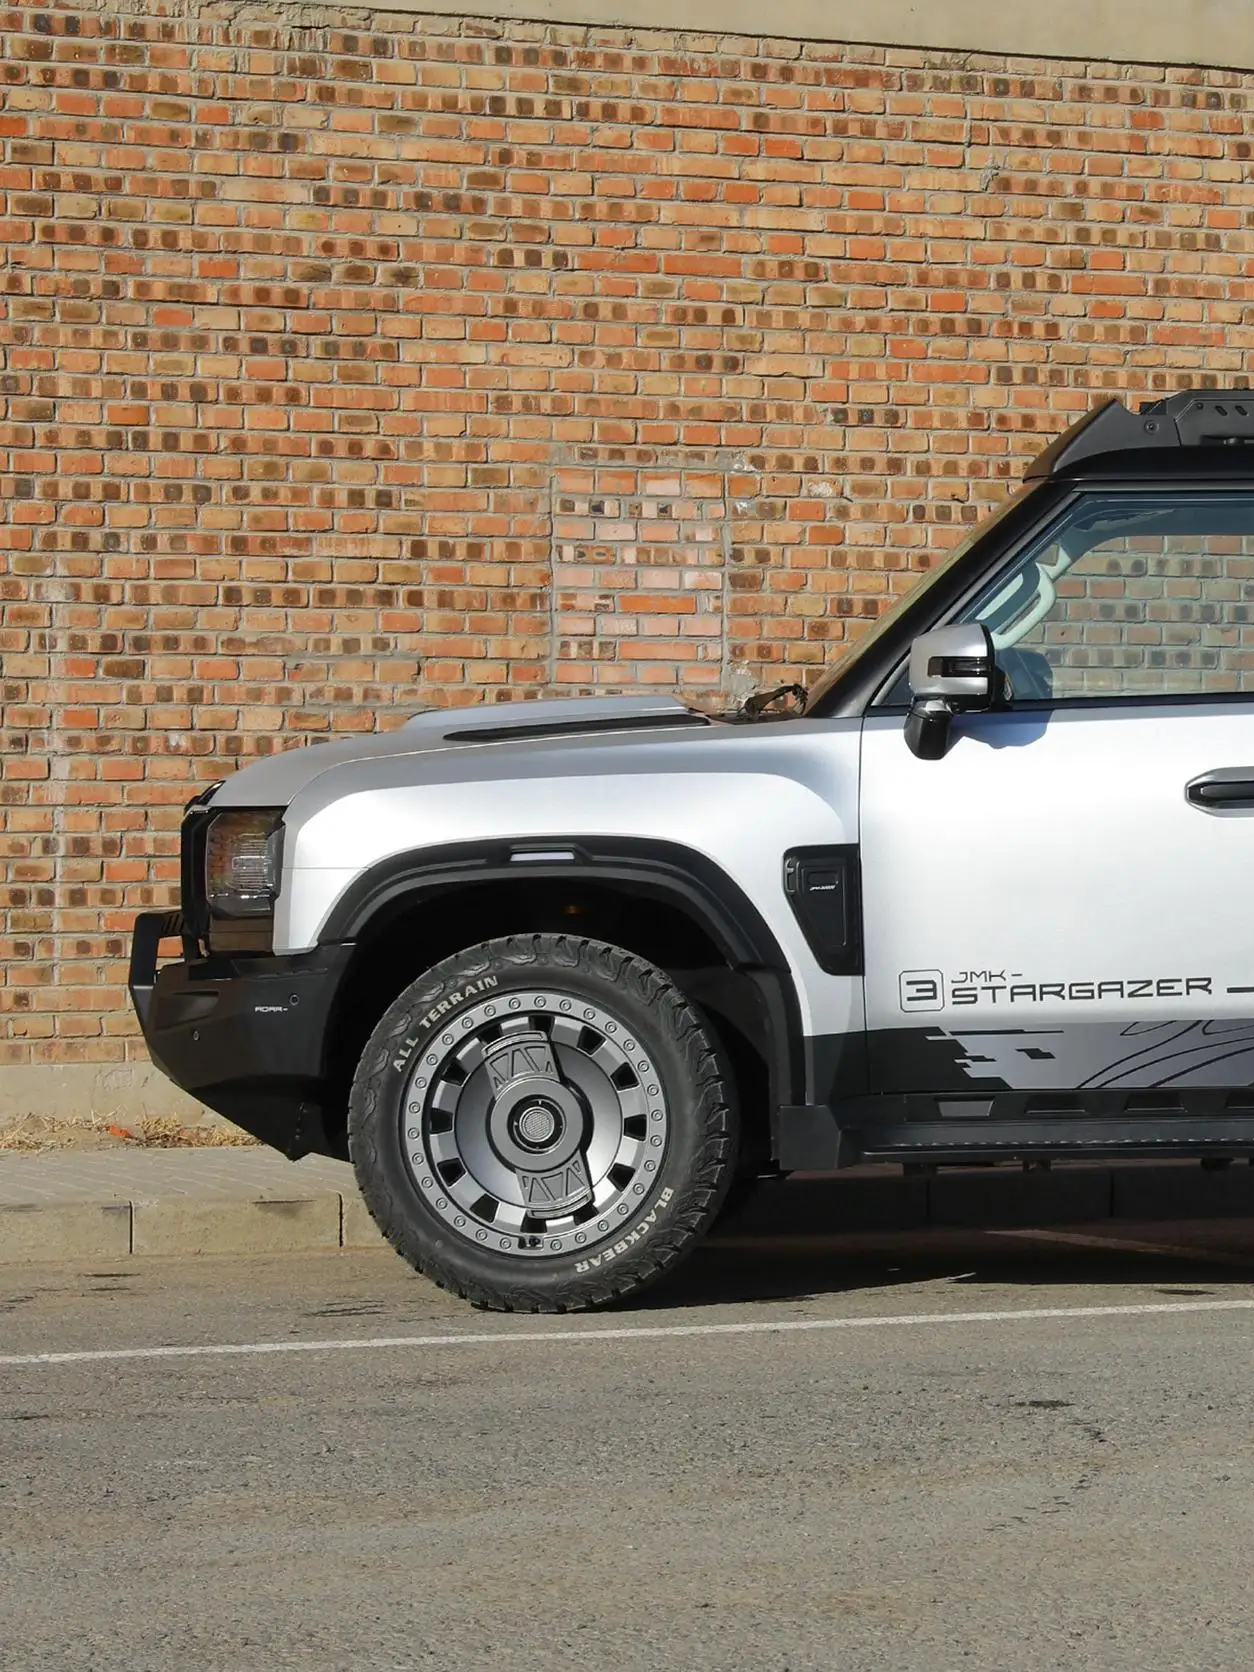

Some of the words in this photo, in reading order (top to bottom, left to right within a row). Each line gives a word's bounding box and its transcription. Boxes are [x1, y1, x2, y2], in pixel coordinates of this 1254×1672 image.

[393, 1037, 419, 1072] ALL
[419, 975, 499, 1029] TERRAIN
[952, 977, 1212, 1005] STARGAZER
[574, 1186, 674, 1273] BLACKBEAR
